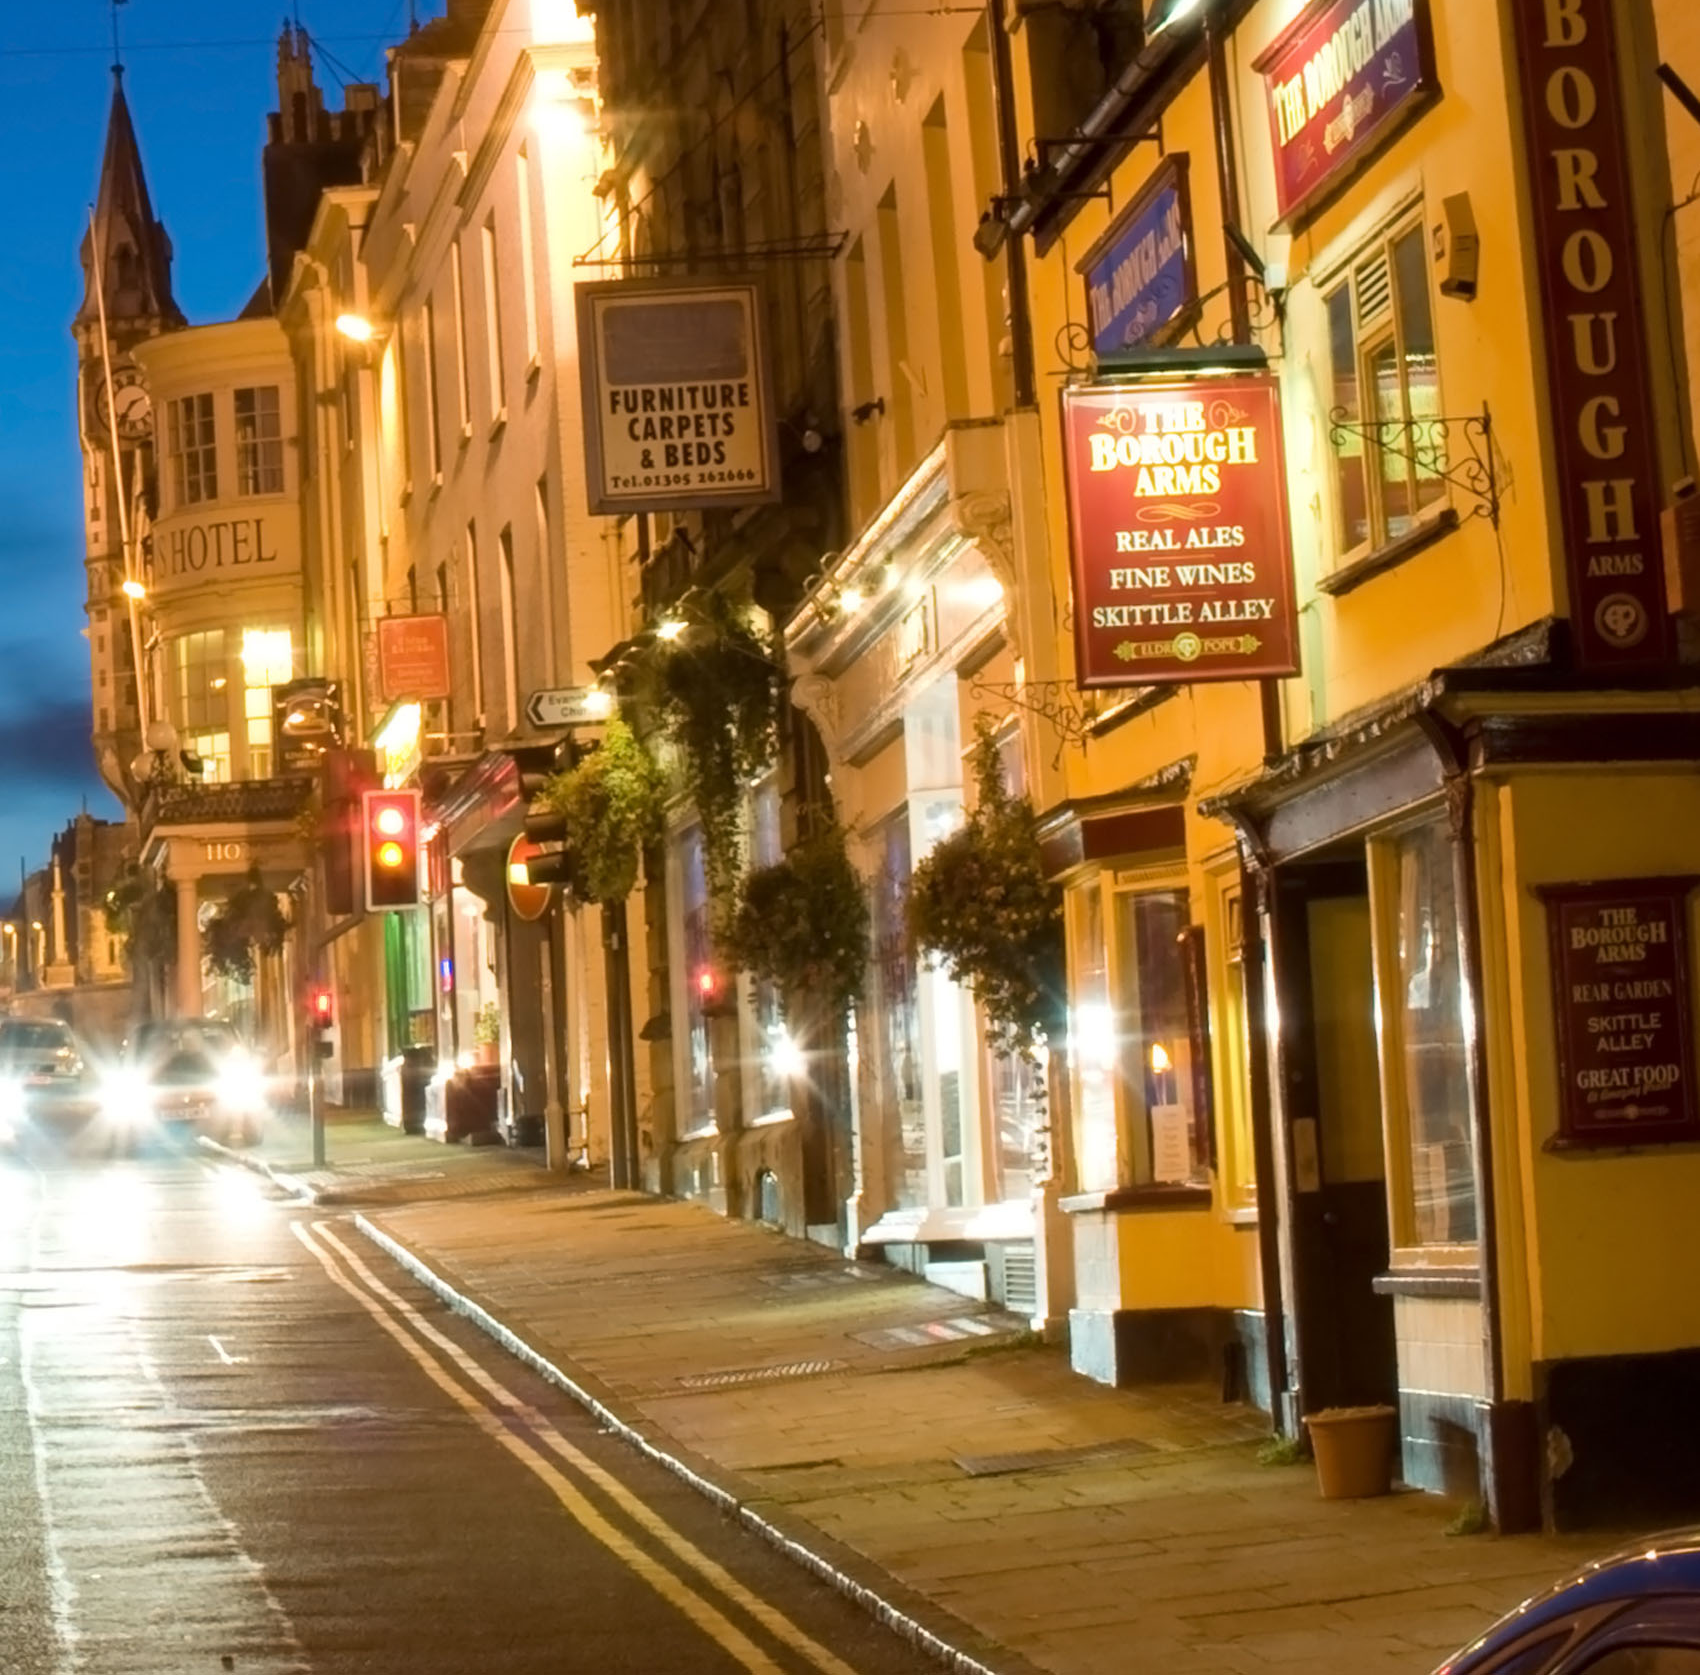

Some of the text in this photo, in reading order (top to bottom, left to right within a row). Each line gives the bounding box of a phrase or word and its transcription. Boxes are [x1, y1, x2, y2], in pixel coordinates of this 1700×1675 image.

[1273, 72, 1307, 149] THE
[610, 383, 749, 415] FURNITURE
[628, 412, 735, 442] CARPETS
[1138, 401, 1207, 434] THE
[640, 440, 726, 470] & BEDS
[1089, 426, 1259, 472] BOROUGH
[1133, 463, 1222, 498] ARMS
[170, 518, 278, 575] HOTEL
[1115, 525, 1246, 553] REAL ALES
[1109, 561, 1257, 590] FINE WINES
[1587, 553, 1644, 578] ARMS
[1092, 598, 1276, 628] SKITTLE ALLEY
[1599, 908, 1638, 927] THE
[1570, 921, 1668, 949] BOROUGH
[1596, 944, 1646, 964] ARMS
[1572, 979, 1672, 1003] REAR GARDEN
[1587, 1012, 1662, 1033] SKITTLE
[1596, 1033, 1655, 1053] ALLEY
[1576, 1064, 1680, 1090] GREAT FOOD
